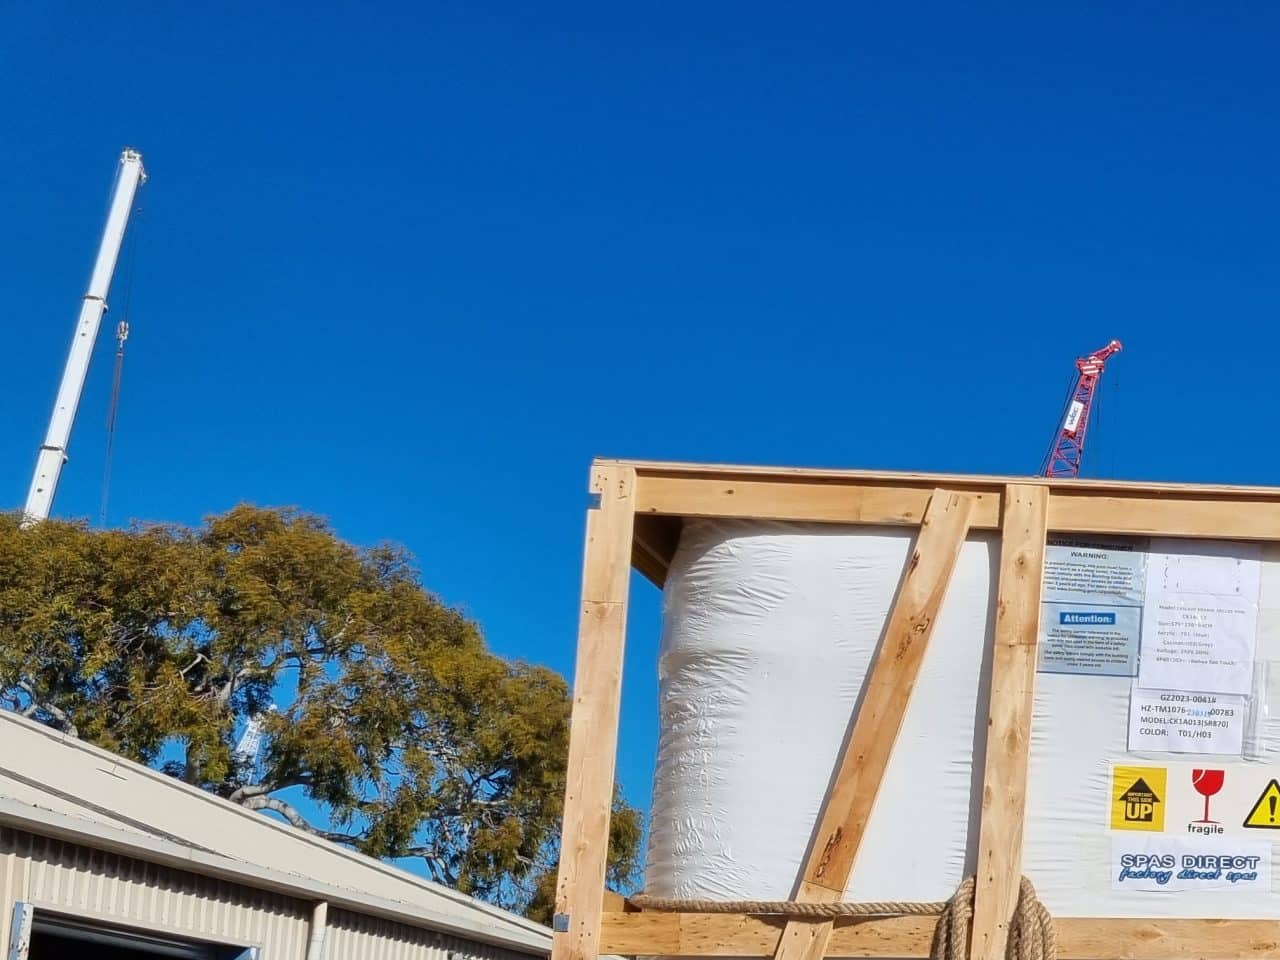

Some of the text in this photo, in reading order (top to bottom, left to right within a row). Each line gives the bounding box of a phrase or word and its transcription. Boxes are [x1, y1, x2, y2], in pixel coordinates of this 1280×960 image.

[1063, 613, 1113, 623] Attention:
[1139, 727, 1169, 737] COLOR:
[1126, 802, 1153, 819] UP
[1187, 824, 1224, 836] fragile
[1120, 854, 1261, 871] SPAS DIRECT
[1118, 867, 1258, 885] factory direct spas
